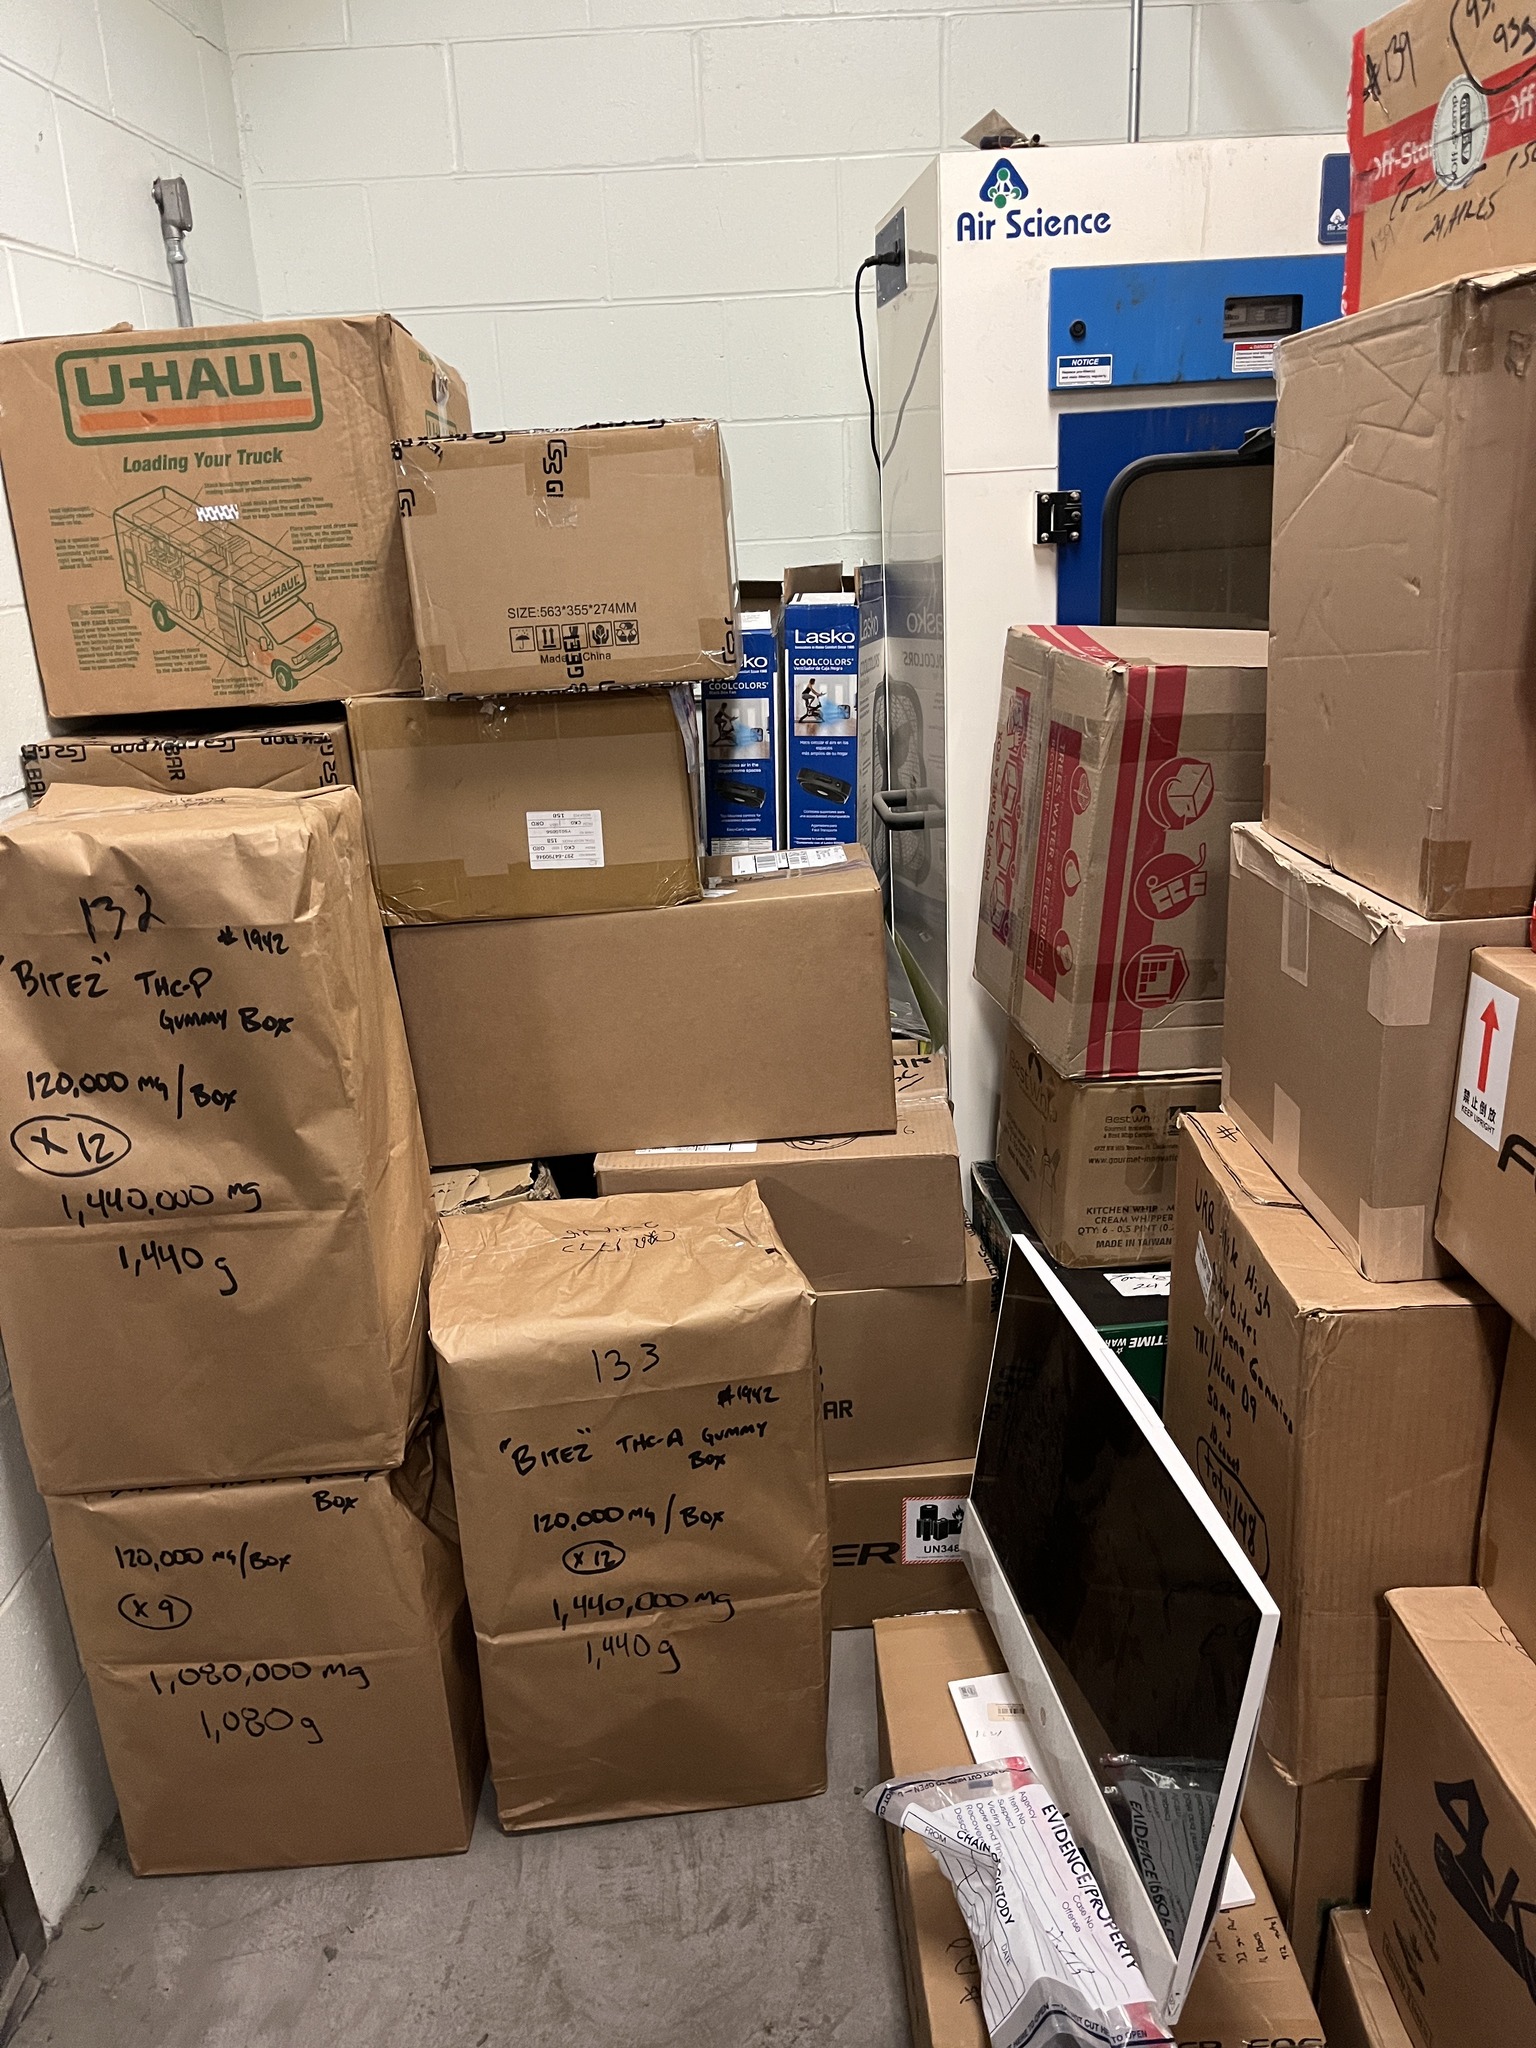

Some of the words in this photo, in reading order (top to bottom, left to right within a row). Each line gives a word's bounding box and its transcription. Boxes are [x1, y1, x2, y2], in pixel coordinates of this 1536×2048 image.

[957, 211, 996, 241] Air
[1006, 207, 1111, 239] Science
[1071, 358, 1099, 366] NOTICE
[73, 349, 304, 408] U-HAUL
[123, 453, 189, 474] Loading
[194, 450, 232, 470] Your
[237, 446, 284, 465] Truck
[262, 574, 300, 605] U-HAUL
[794, 629, 855, 644] Lasko
[583, 652, 611, 661] China
[1055, 743, 1066, 797] TREES,
[1048, 801, 1060, 857] WATER
[79, 885, 166, 944] 132
[1037, 874, 1052, 975] ELECTRICITY
[27, 1070, 129, 1101] 120,000
[1105, 1115, 1151, 1124] BestWh
[1460, 1104, 1474, 1118] KEEP
[1473, 1114, 1495, 1136] UPRIGHT
[1462, 1088, 1497, 1124] 禁止倒放
[61, 1185, 215, 1228] 1,440,000
[1086, 1206, 1130, 1215] KITCHEN
[1094, 1216, 1128, 1225] CREAM
[1130, 1214, 1174, 1223] WHIPPER
[1096, 1239, 1123, 1249] MADE
[1125, 1238, 1136, 1247] IN
[1137, 1237, 1173, 1247] TAIWAN
[1102, 1226, 1108, 1234] 6
[1117, 1225, 1132, 1233] 0.5
[118, 1240, 204, 1278] 1,440
[592, 1342, 661, 1383] 133
[823, 1399, 852, 1419] AR
[533, 1506, 623, 1533] 120,000
[114, 1544, 203, 1572] 120,000
[593, 1548, 616, 1568] 12
[832, 1541, 901, 1567] ER
[923, 1544, 960, 1554] UN348
[158, 1599, 174, 1623] 9
[552, 1591, 690, 1632] 1,440,000
[586, 1633, 653, 1670] 1,440
[150, 1662, 312, 1695] 1,080,000
[200, 1706, 294, 1745] 1,080
[987, 1800, 1001, 1827] Victim
[998, 1798, 1016, 1830] Suspect
[1008, 1795, 1020, 1814] Item
[1019, 1790, 1037, 1820] Agency
[924, 1826, 947, 1844] FROM
[976, 1802, 989, 1823] Date
[985, 1823, 998, 1842] and
[956, 1829, 992, 1853] CHAIN
[1061, 1901, 1081, 1933] Offense
[1072, 1894, 1087, 1917] Case
[1084, 1915, 1096, 1932] No.
[1000, 1943, 1013, 1967] DATE
[1084, 2018, 1099, 2032] CUT
[1111, 2034, 1124, 2044] TO
